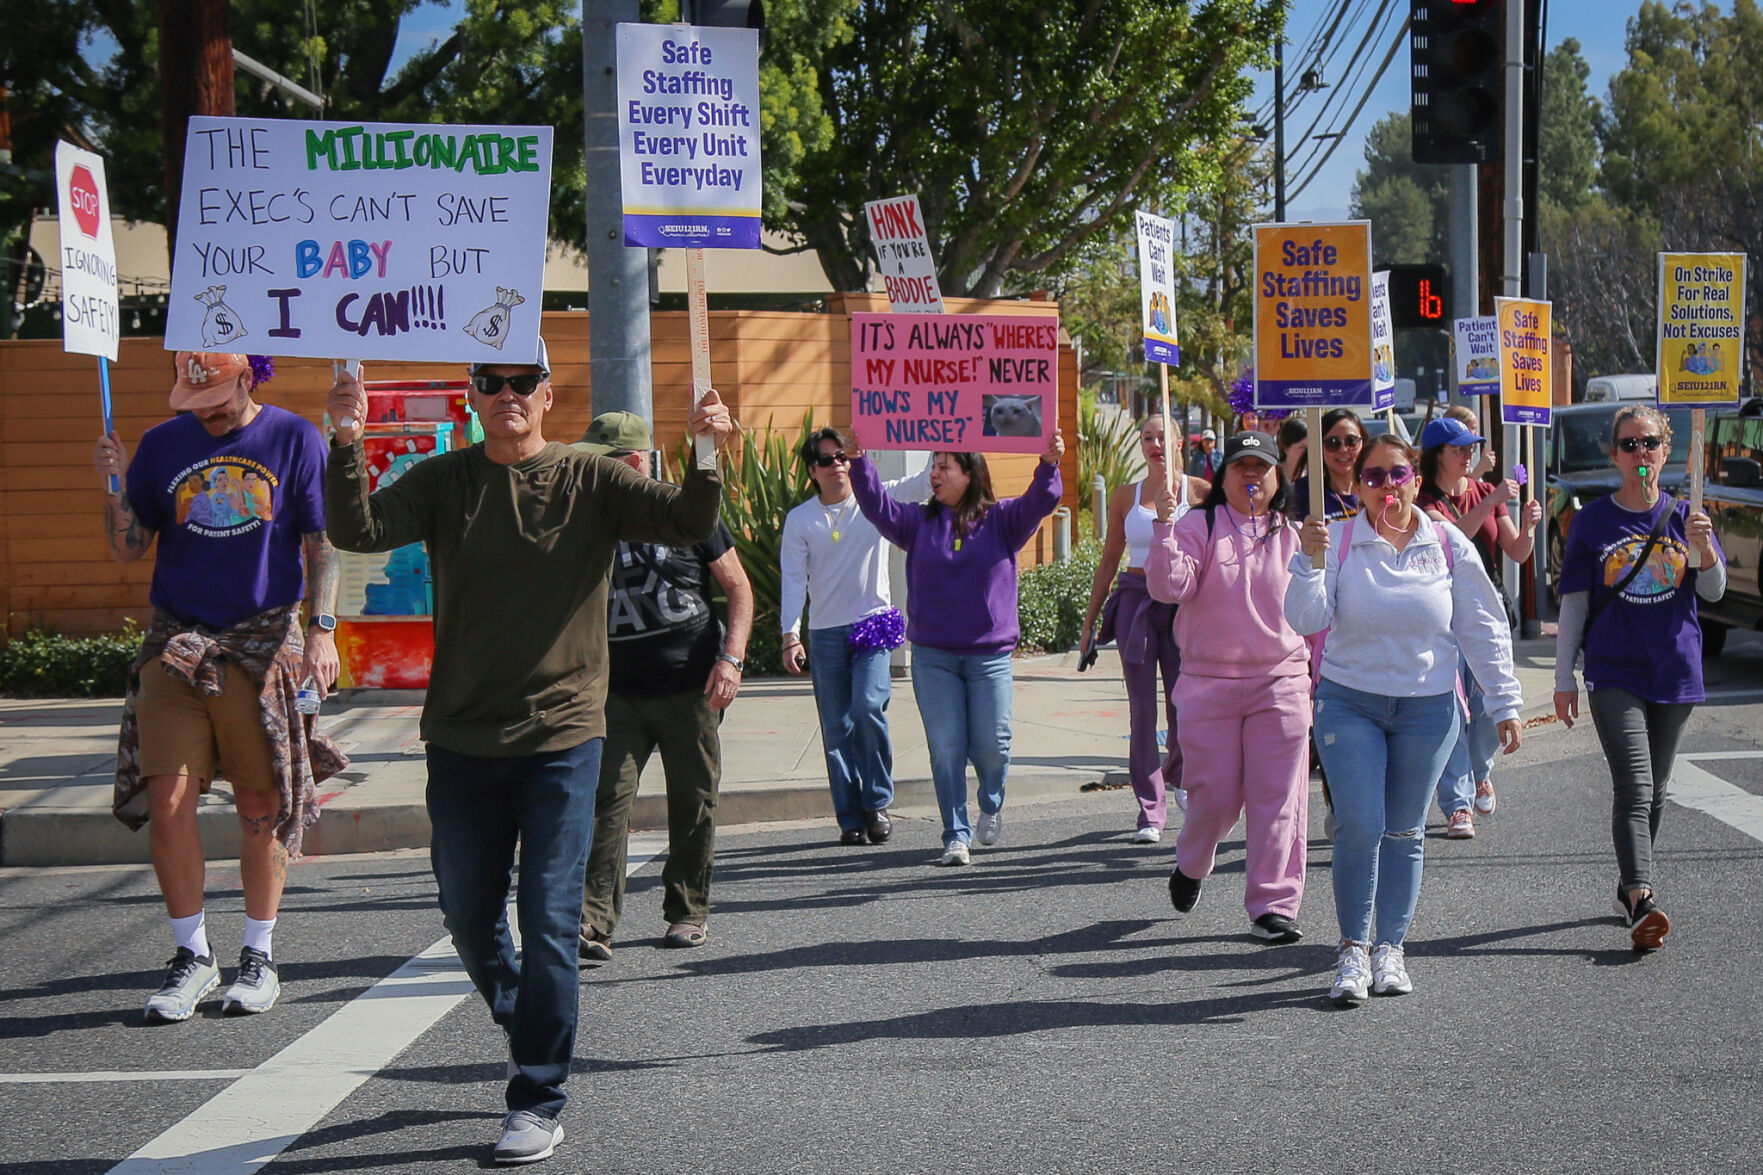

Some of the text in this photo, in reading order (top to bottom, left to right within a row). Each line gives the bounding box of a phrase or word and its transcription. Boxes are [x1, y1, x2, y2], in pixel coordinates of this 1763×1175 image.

[662, 40, 712, 65] Safe
[643, 70, 733, 101] Staffing
[629, 100, 749, 129] Every Shift
[195, 126, 540, 175] THE MILLIONAIRE
[634, 131, 747, 160] Every Unit
[641, 162, 743, 191] Everyday
[72, 187, 98, 217] STOP
[199, 187, 509, 227] EXEC'S CAN'T SAVE
[870, 200, 923, 240] HONK
[1139, 216, 1171, 243] Patients
[192, 239, 490, 279] YOUR BABY BUT
[878, 241, 925, 259] IF YOU'RE
[1149, 240, 1166, 265] Can't
[1282, 239, 1337, 267] Safe
[64, 247, 115, 287] IGNORING
[898, 262, 905, 275] A
[1151, 262, 1166, 286] Wait
[1675, 266, 1733, 282] On Strike
[885, 276, 938, 304] BADDIE
[1263, 270, 1361, 301] Staffing
[1677, 286, 1729, 301] For Real
[67, 294, 118, 341] SAFETY!
[267, 288, 302, 338] I
[335, 284, 447, 337] CAN!!!!
[1276, 302, 1347, 329] Saves
[1373, 301, 1386, 319] an't
[1514, 310, 1539, 329] Safe
[1671, 304, 1734, 322] Solutions,
[861, 320, 1056, 352] IT'S ALWAYS "WHERE'S
[1459, 320, 1498, 332] Patient
[1468, 332, 1495, 343] Can't
[1663, 323, 1740, 338] Not Excuses
[1281, 333, 1344, 359] Lives
[1470, 343, 1494, 354] Wait
[1503, 330, 1547, 355] Staffing
[866, 356, 1050, 386] MY NURSE!" NEVER
[1512, 352, 1543, 372] Saves
[1515, 373, 1541, 392] Lives
[1677, 381, 1727, 391] SEIU121RN
[853, 388, 959, 416] "HOW'S MY
[886, 417, 973, 443] NURSE?"
[1242, 436, 1260, 446] alo
[167, 456, 279, 493] FLEXING OUR HEALTHCARE POWER
[187, 523, 203, 535] FOR
[231, 520, 261, 536] SAFETY!
